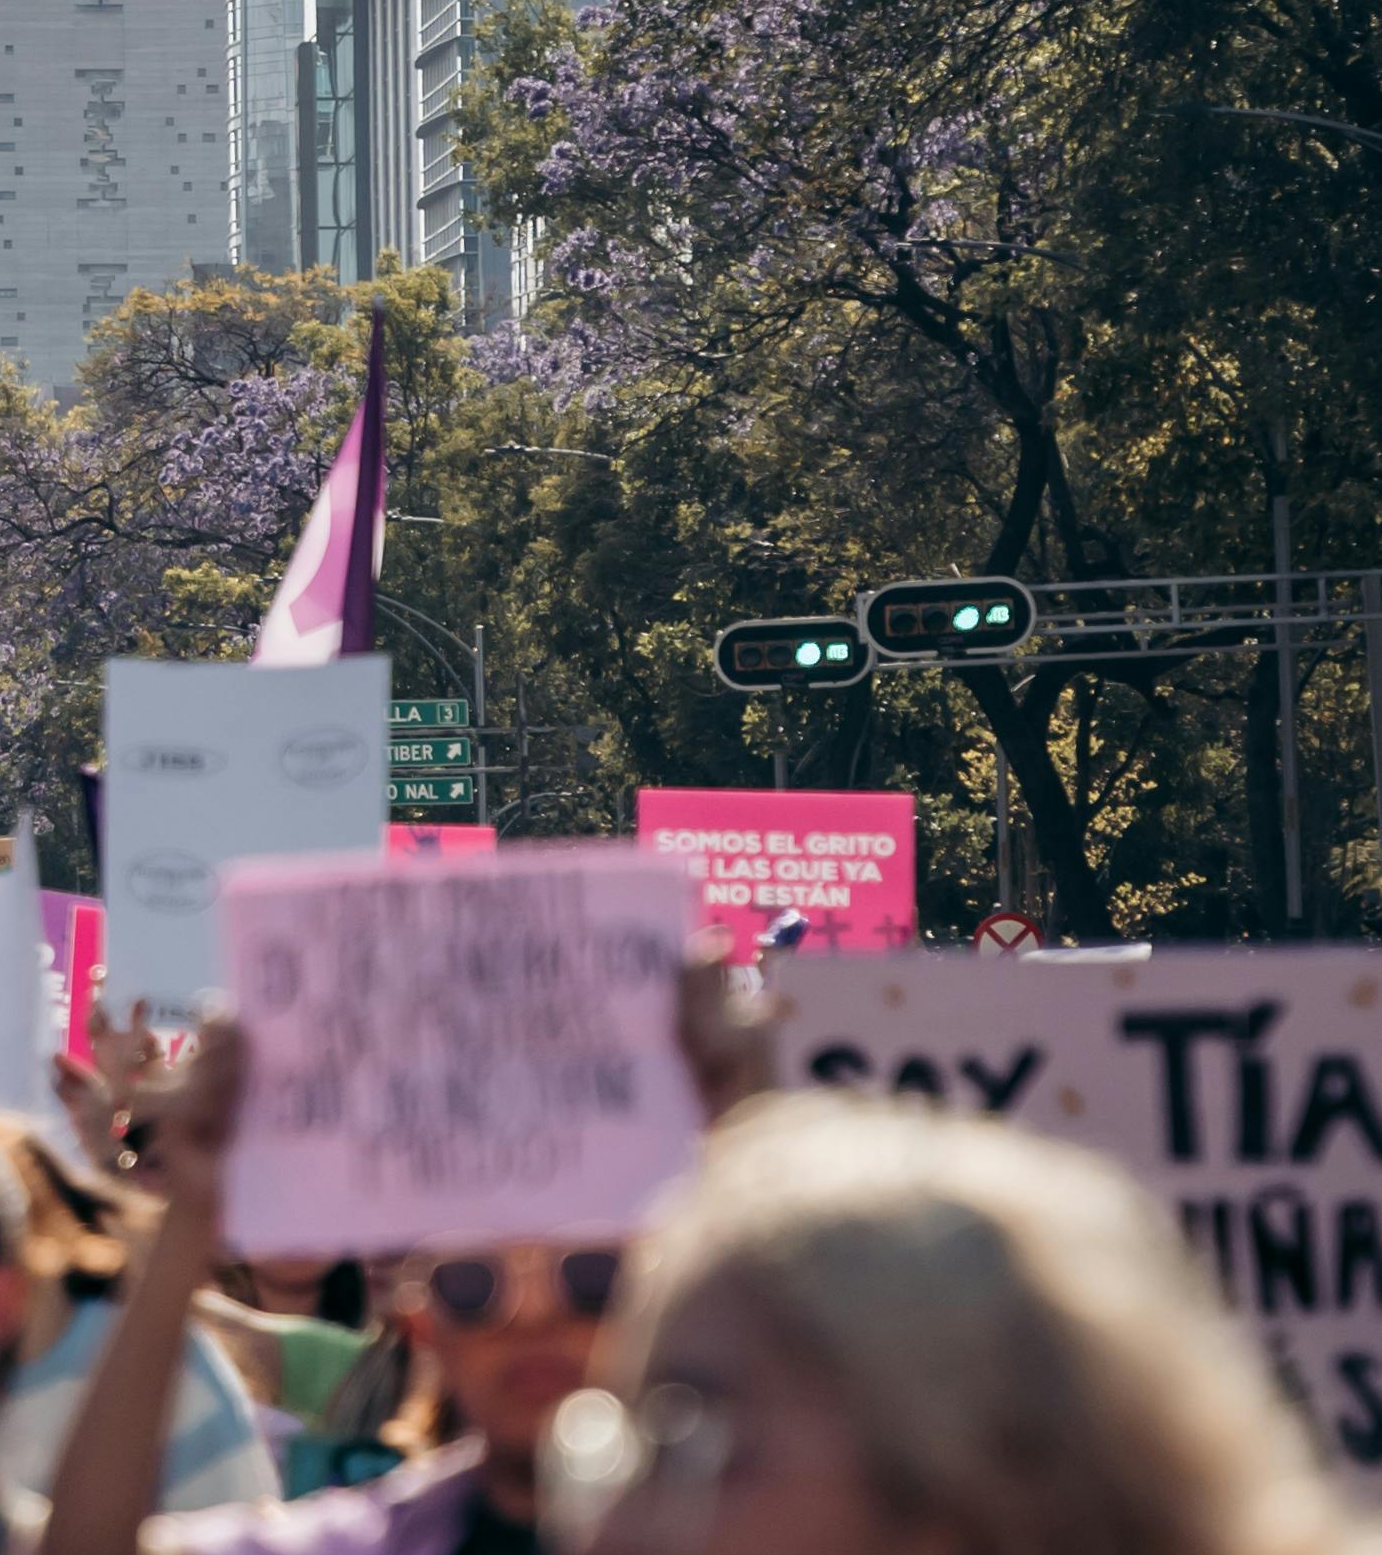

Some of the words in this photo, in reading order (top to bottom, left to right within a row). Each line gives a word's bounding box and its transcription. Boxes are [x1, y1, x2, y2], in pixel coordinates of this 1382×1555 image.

[405, 784, 439, 799] NAL
[655, 831, 763, 854] SOMOS
[766, 833, 803, 855] EL
[807, 834, 896, 857] GRITO
[715, 858, 771, 880] LAS
[775, 860, 839, 882] QUE
[842, 861, 883, 883] YA
[704, 884, 752, 906] NO
[755, 882, 851, 908] ESTÁN
